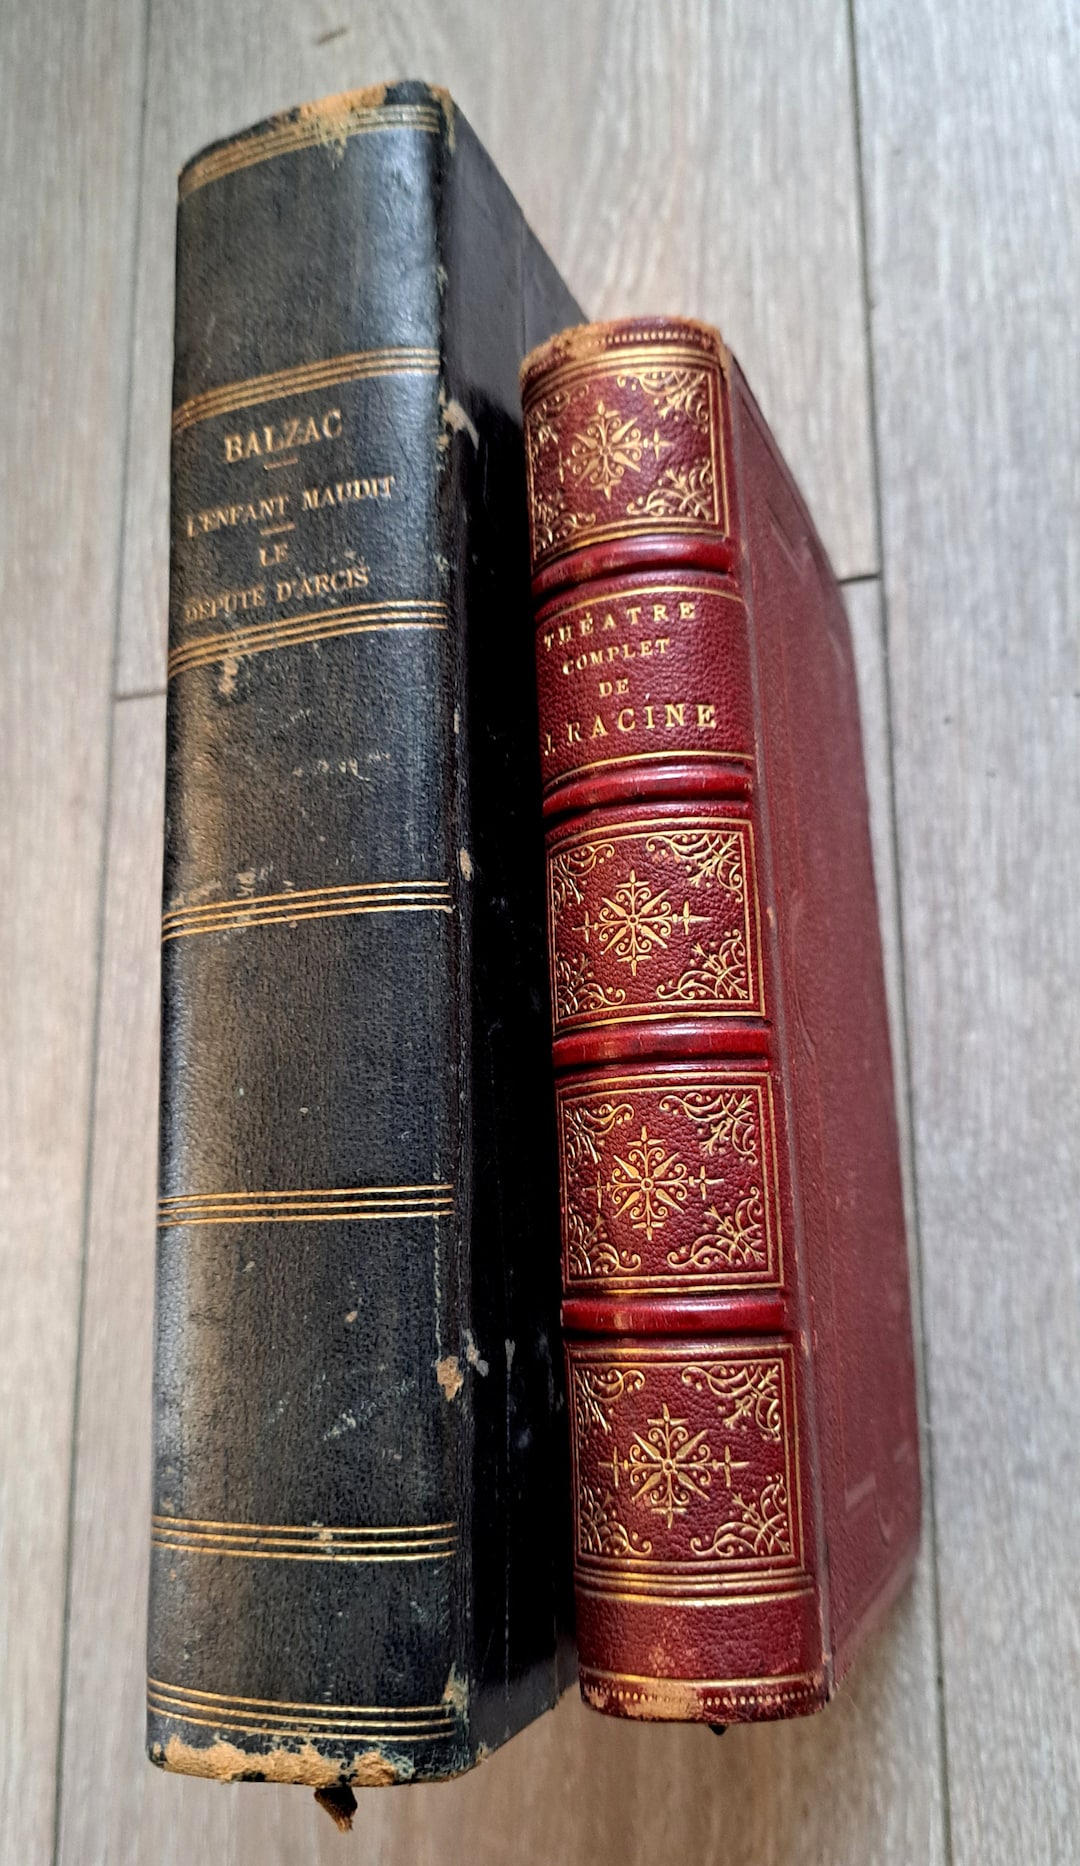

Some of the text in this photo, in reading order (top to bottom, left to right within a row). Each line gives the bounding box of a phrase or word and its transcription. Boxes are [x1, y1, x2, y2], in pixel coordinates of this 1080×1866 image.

[223, 409, 343, 463] BALZAC
[301, 475, 395, 511] MAUDIT
[258, 543, 290, 568] LE
[276, 567, 370, 604] D'ARCIS
[562, 638, 671, 675] COMPLET
[599, 678, 629, 698] DE
[567, 703, 717, 746] RACINE
